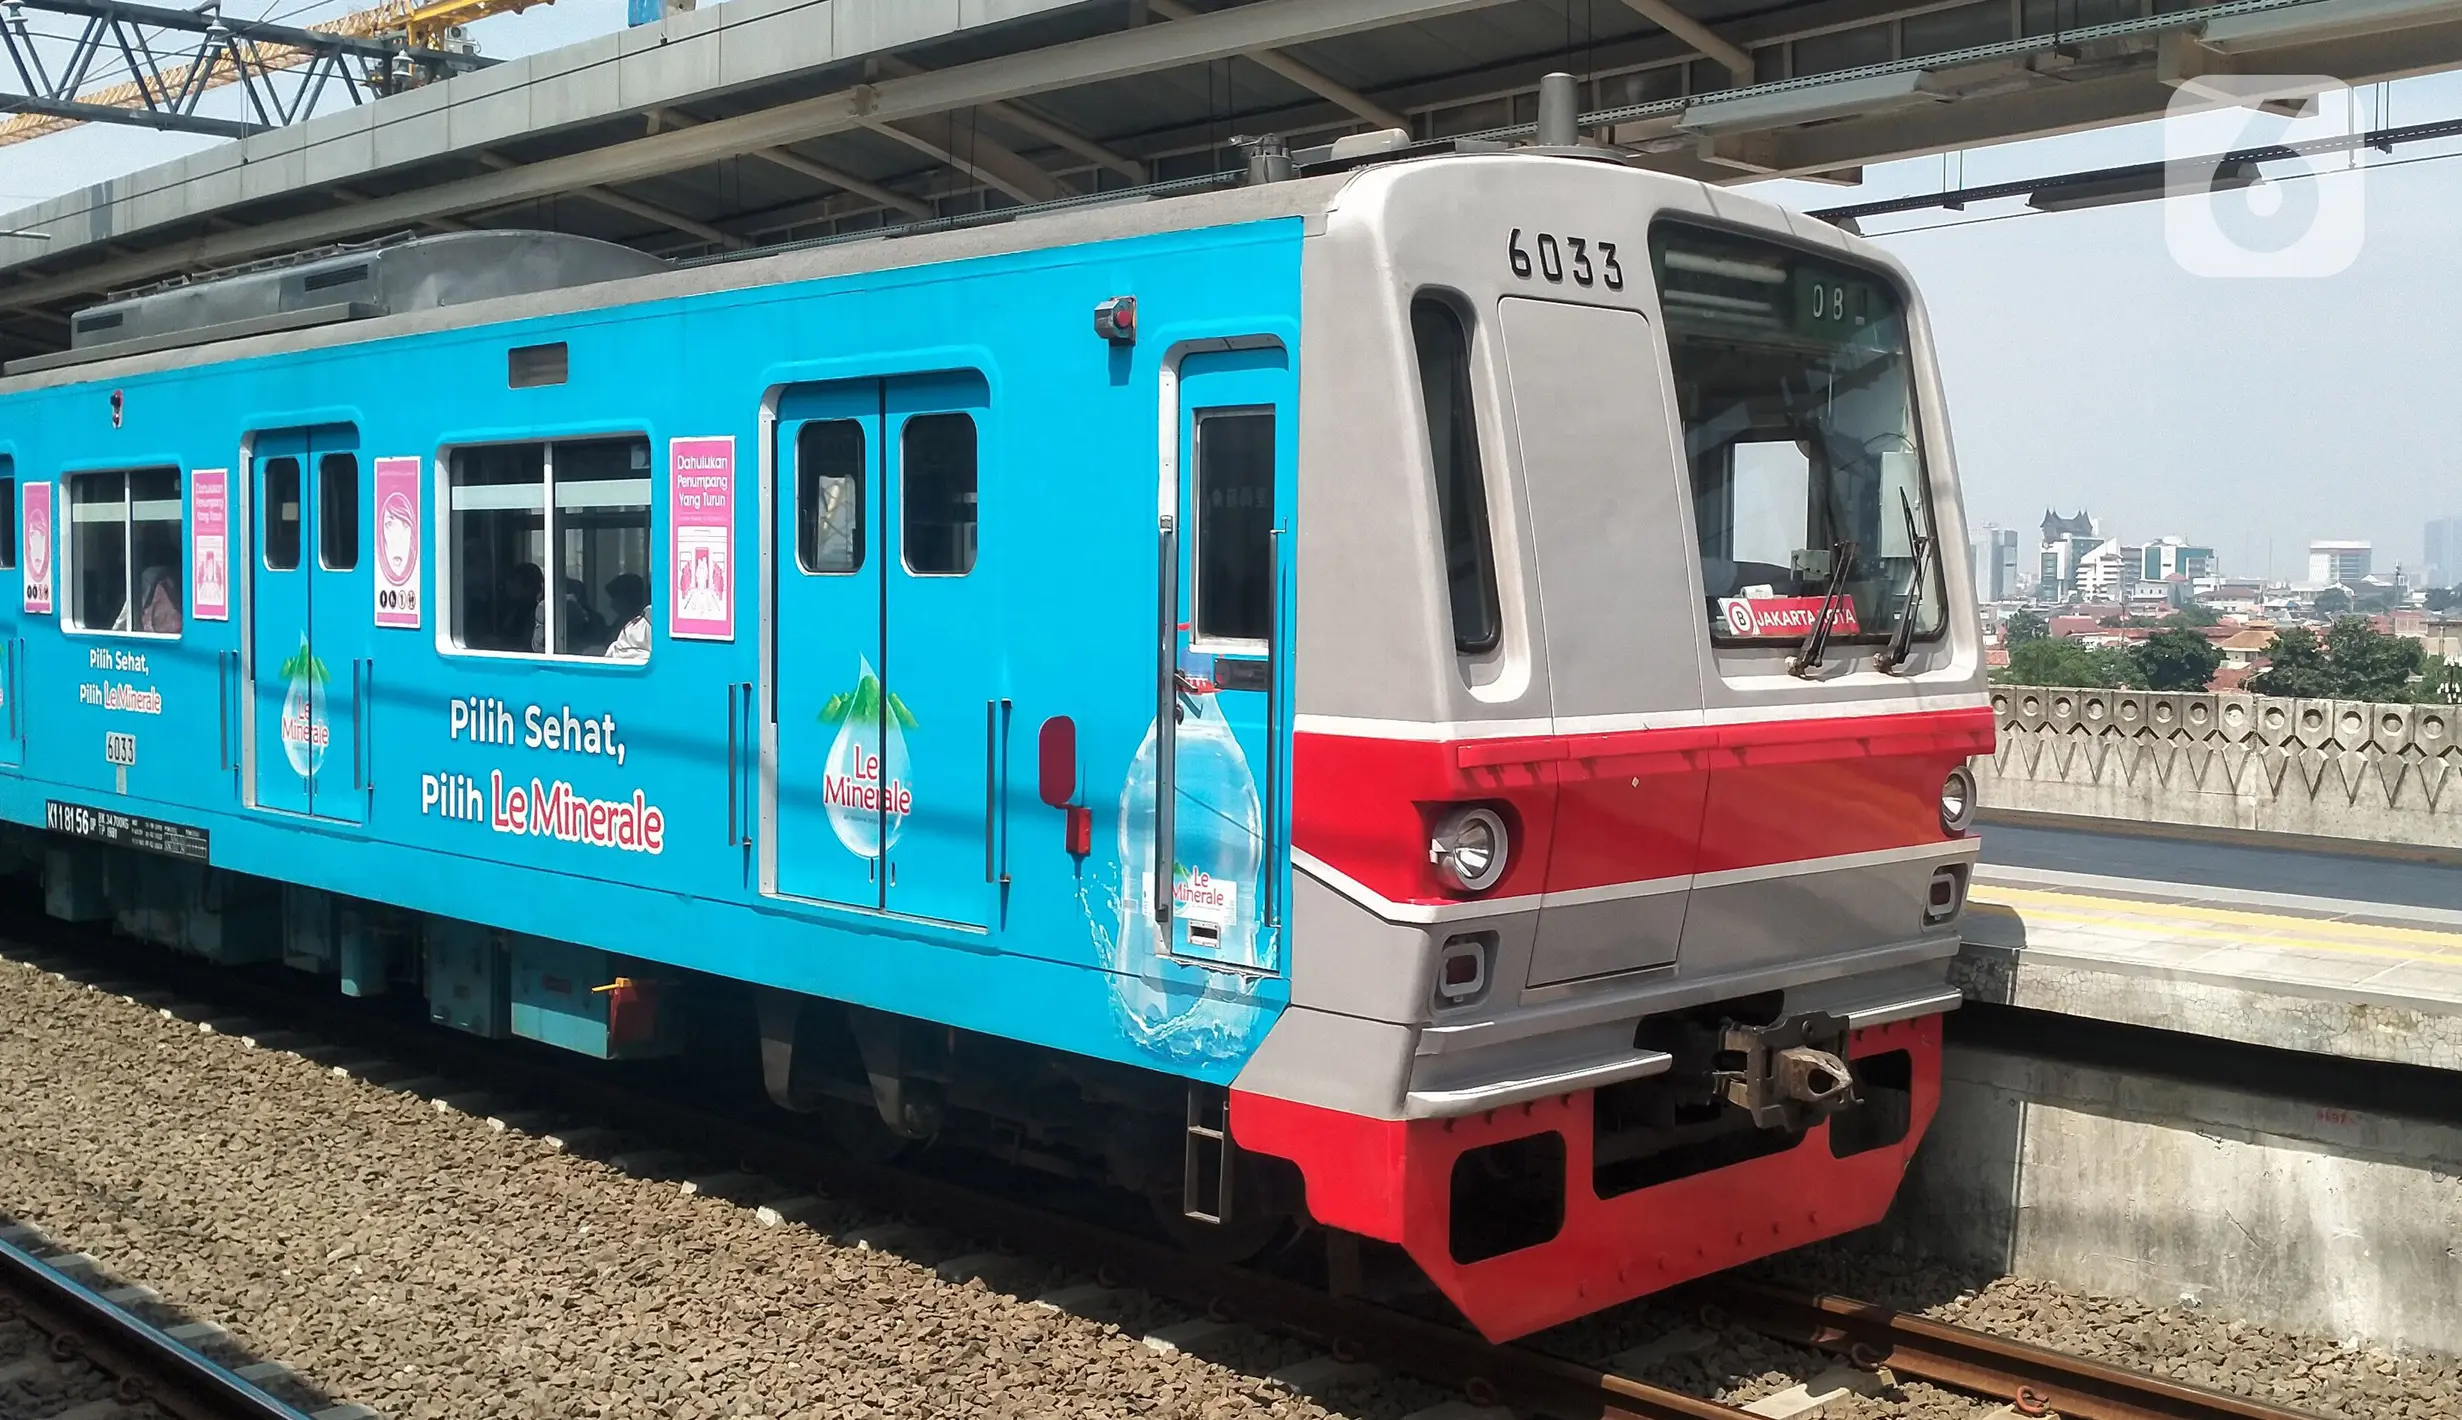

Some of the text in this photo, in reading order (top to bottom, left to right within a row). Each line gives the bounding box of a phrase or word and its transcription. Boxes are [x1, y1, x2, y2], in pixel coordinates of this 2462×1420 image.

[1508, 227, 1624, 290] 6033
[677, 455, 728, 470] Dahulukan
[677, 474, 728, 491] Penumpang
[679, 491, 726, 510] Yang Turun
[1736, 610, 1747, 626] B
[1757, 608, 1856, 627] JAKARTA OTA
[89, 647, 149, 676] Pilih Sehat,
[80, 683, 102, 705] Pilih
[282, 717, 329, 745] Mineale
[450, 696, 626, 765] Pilih Sehat,
[107, 735, 134, 763] 6033
[855, 745, 879, 780] Le
[421, 772, 483, 822] Pilih
[824, 774, 911, 814] Minerale
[1194, 866, 1209, 888] Le
[1172, 883, 1224, 906] Minerale
